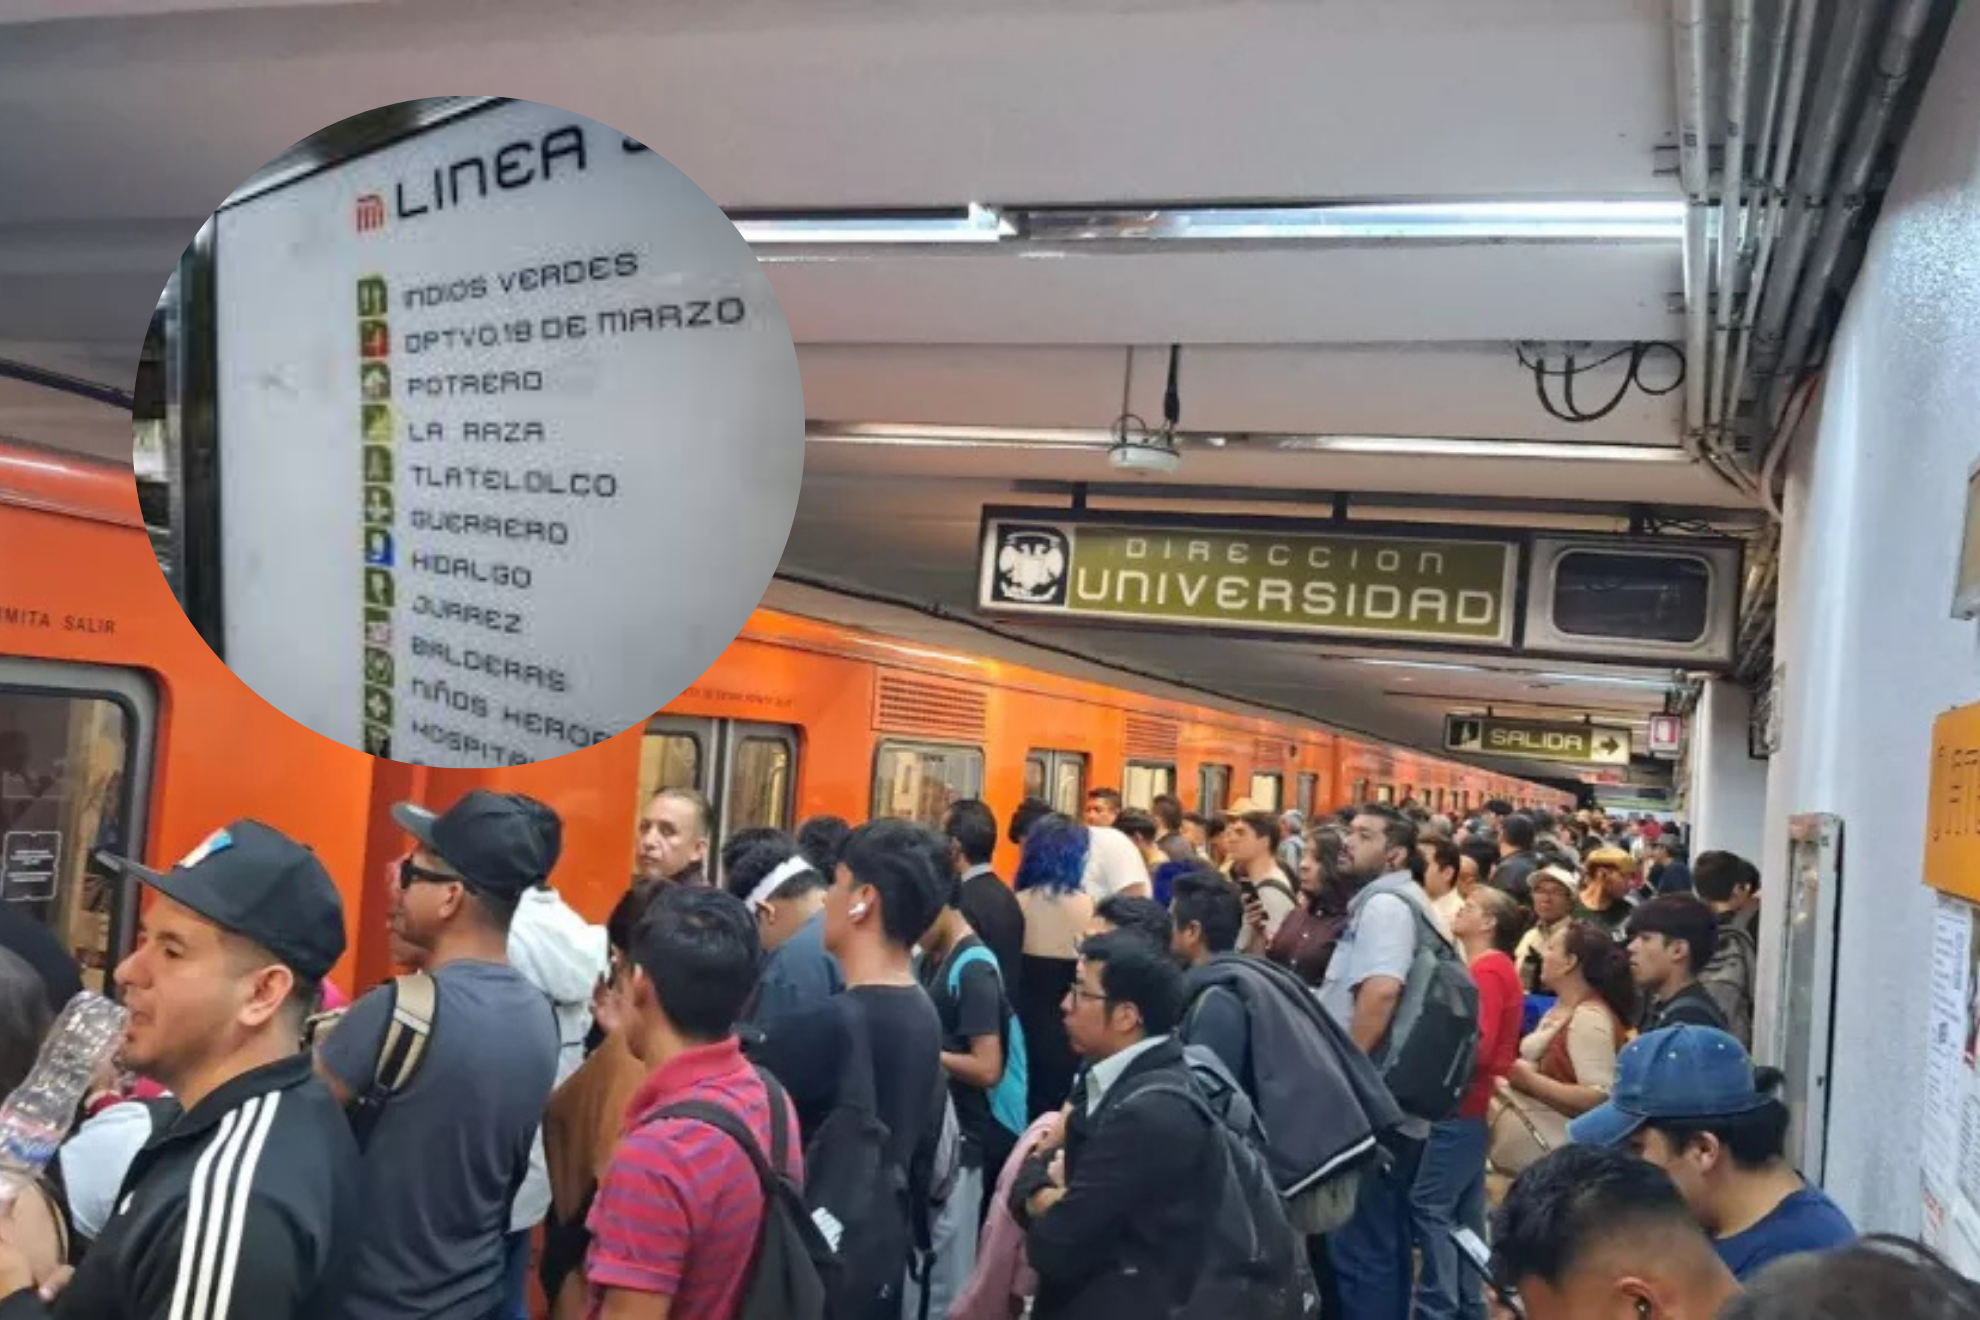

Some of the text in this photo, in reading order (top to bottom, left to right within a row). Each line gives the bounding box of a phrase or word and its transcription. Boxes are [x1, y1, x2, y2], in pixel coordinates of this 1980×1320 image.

[396, 125, 586, 219] LINEA
[404, 252, 640, 309] INDIOS VERDES
[542, 316, 588, 340] DE
[599, 297, 746, 334] MARZO
[408, 370, 543, 397] POTRERO
[408, 421, 545, 443] LA RAZA
[410, 466, 617, 497] TLATELOLCO
[411, 510, 568, 545] GUERRERO
[411, 551, 532, 589] HIDALGO
[1126, 537, 1444, 574] DIRECCION
[412, 595, 522, 634] JUAREZ
[1076, 567, 1495, 625] UNIVERSIDAD
[0, 606, 117, 635] MITA SALIR
[412, 636, 566, 692] BALDERAS
[411, 677, 488, 718] NIÑOS
[1490, 728, 1583, 751] SALIDA
